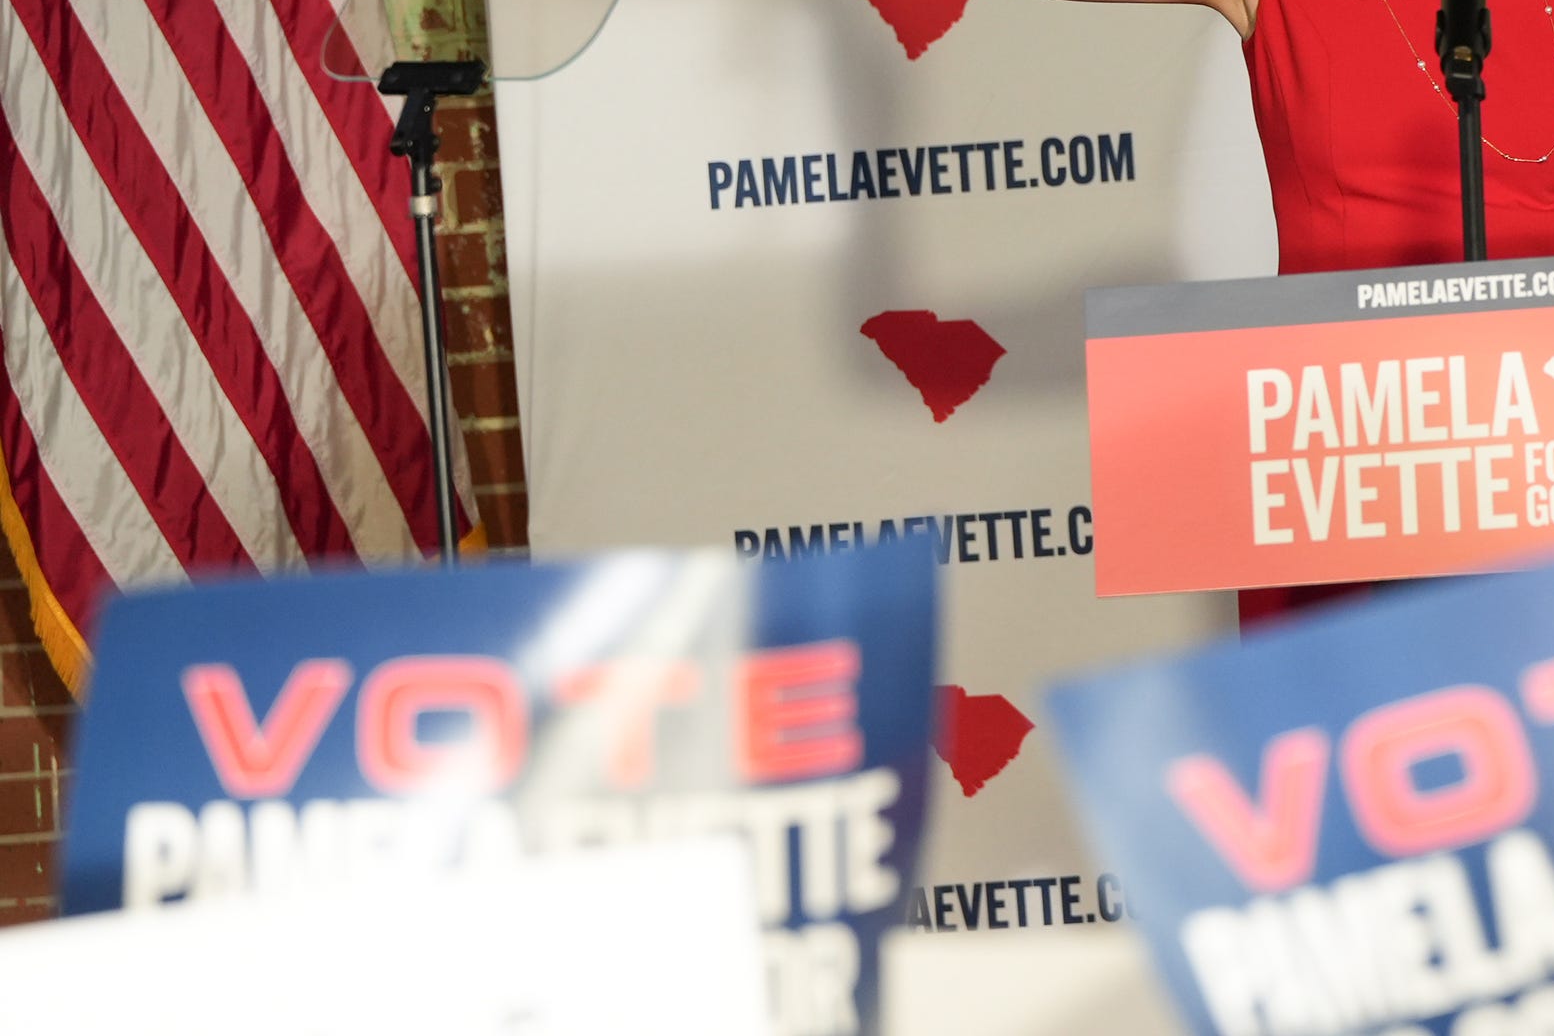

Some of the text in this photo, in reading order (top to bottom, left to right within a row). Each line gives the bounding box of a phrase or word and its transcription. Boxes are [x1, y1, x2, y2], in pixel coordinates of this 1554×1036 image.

[708, 132, 1136, 209] PAMELAEVETTE.COM
[1247, 351, 1540, 454] PAMELA
[1250, 444, 1518, 545] EVETTE
[181, 638, 862, 797] VOTE
